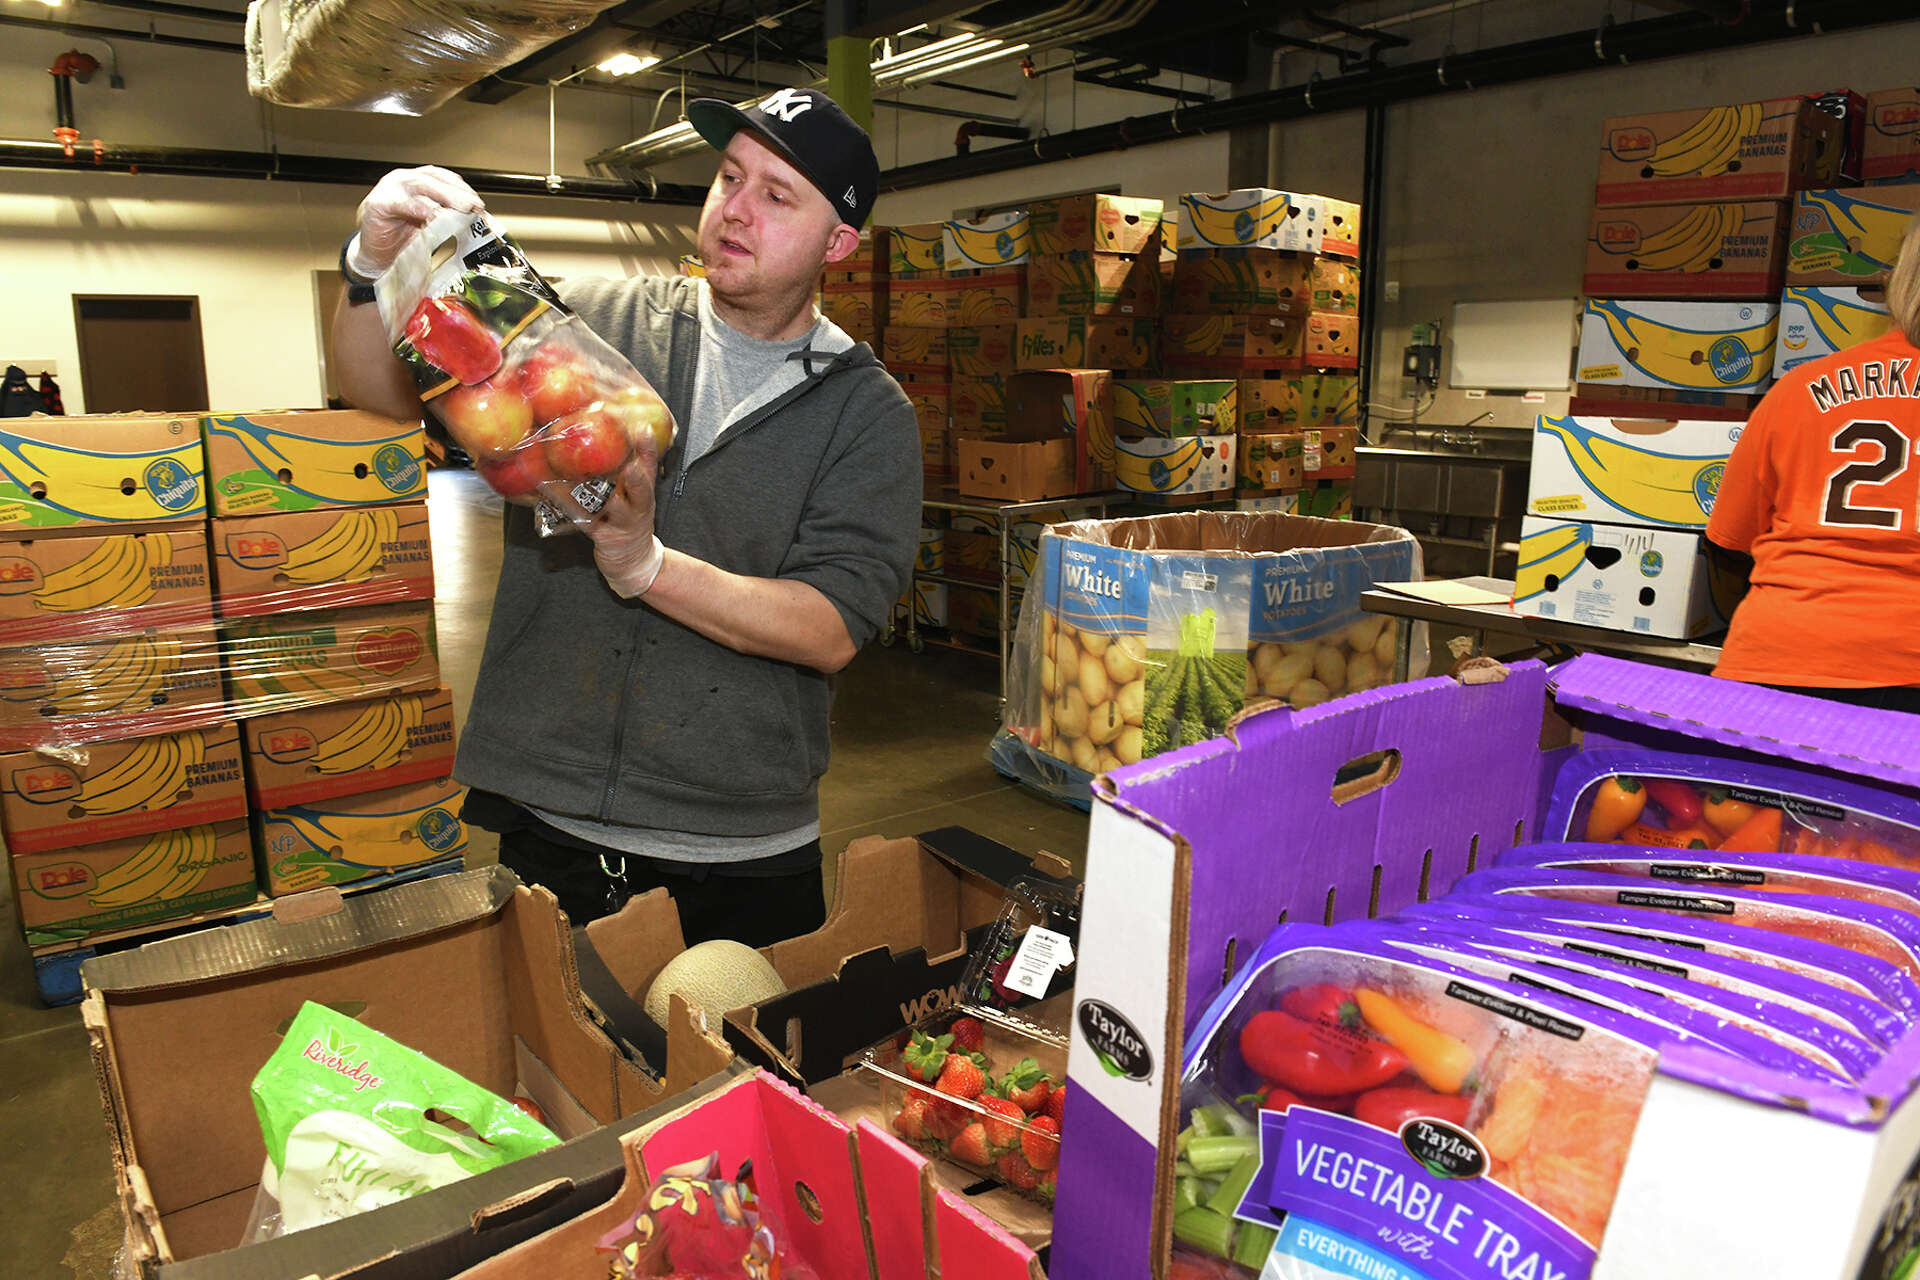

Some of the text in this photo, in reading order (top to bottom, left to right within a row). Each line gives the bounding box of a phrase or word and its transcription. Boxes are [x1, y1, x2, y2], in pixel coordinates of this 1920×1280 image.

[1740, 132, 1787, 145] PREMIUM
[1739, 144, 1786, 158] BANANAS
[1721, 235, 1768, 247] PREMIUM
[1720, 247, 1768, 259] BANANAS
[1714, 355, 1752, 378] Chiquita
[156, 475, 198, 506] Chiquita
[237, 538, 279, 556] Dole
[381, 540, 428, 553] PREMIUM
[381, 552, 430, 565] BANANAS
[0, 563, 34, 580] ole
[149, 563, 203, 577] PREMIUM
[151, 576, 205, 590] BANANAS
[1065, 563, 1122, 599] White
[1264, 577, 1335, 607] White
[406, 721, 450, 737] PREMIUM
[270, 732, 311, 751] Dole
[407, 732, 453, 748] BANANAS
[185, 758, 238, 776] PREMIUM
[26, 771, 72, 791] Dole
[186, 770, 241, 789] BANANAS
[1731, 790, 1758, 803] Tamper
[177, 851, 248, 874] ORGANIC
[41, 866, 88, 886] Dole
[1653, 867, 1680, 877] Tamper
[1620, 893, 1648, 904] Tamper
[1650, 896, 1678, 906] Evident
[1450, 984, 1481, 1001] Tamper
[1088, 1003, 1143, 1058] Taylor
[303, 1039, 381, 1091] Riveridge
[1417, 1120, 1477, 1163] Taylor
[1422, 1145, 1458, 1169] FARMS
[1296, 1139, 1473, 1244] VEGETABLE
[1378, 1223, 1434, 1262] with
[1297, 1228, 1398, 1280] EVERYTHING
